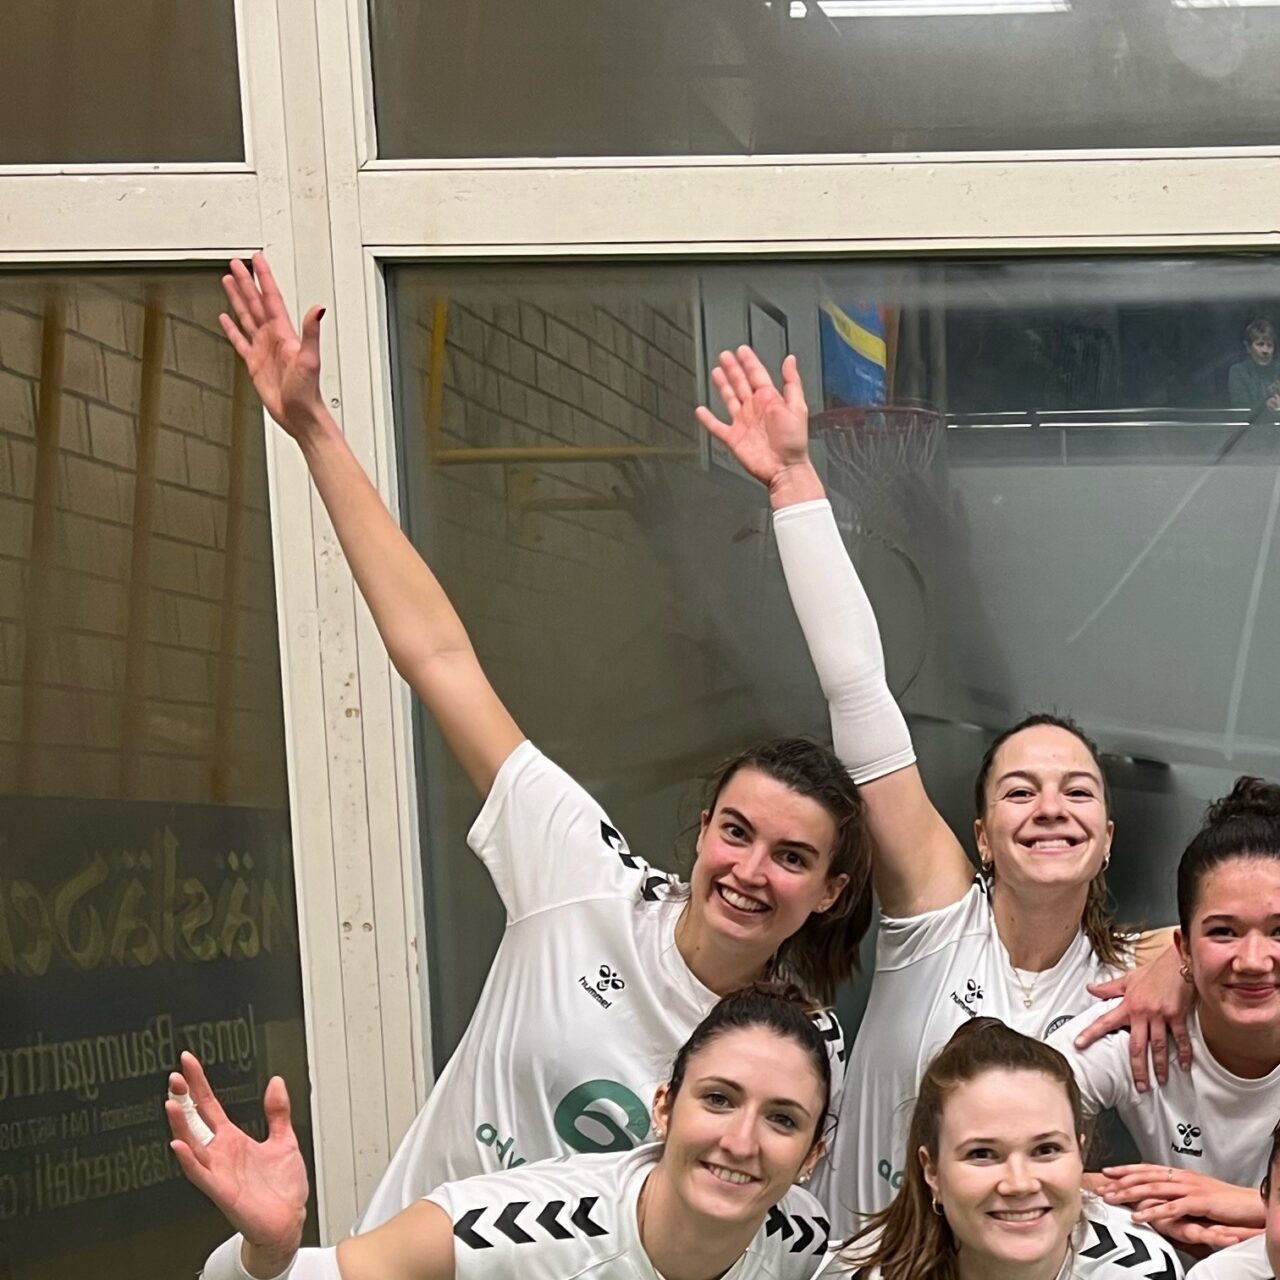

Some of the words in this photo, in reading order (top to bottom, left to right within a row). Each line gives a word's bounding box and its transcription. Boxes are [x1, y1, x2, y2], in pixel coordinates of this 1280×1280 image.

[578, 976, 612, 1009] hummel
[554, 1079, 650, 1153] 6
[1171, 1141, 1203, 1157] hummel
